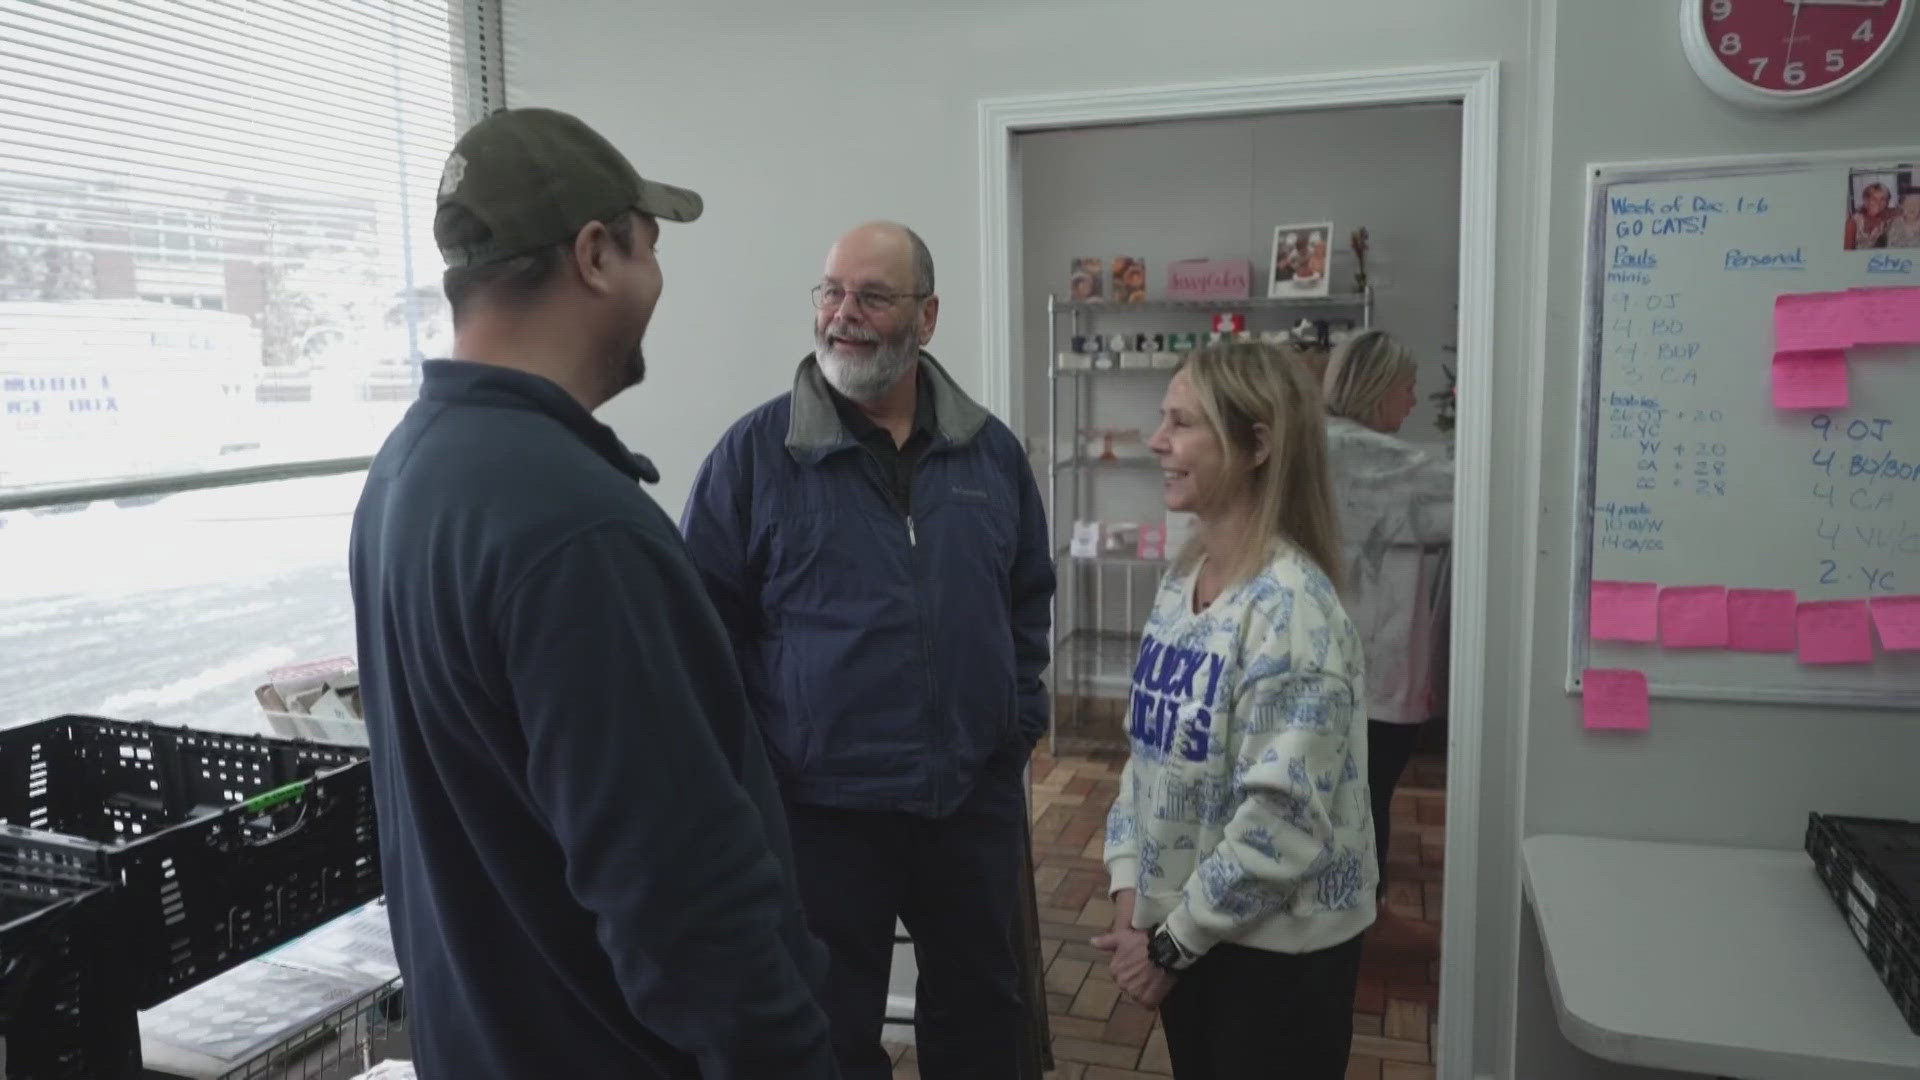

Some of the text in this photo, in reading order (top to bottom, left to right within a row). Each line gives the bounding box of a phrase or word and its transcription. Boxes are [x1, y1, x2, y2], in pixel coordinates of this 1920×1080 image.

[1710, 0, 1732, 21] 9
[1852, 19, 1874, 42] 4
[1719, 33, 1742, 55] 8
[1749, 57, 1769, 81] 7
[1825, 49, 1845, 72] 5
[1783, 62, 1806, 85] 6
[1611, 196, 1655, 215] Week
[1660, 194, 1683, 214] of
[1616, 214, 1707, 238] GO CATS!
[1811, 415, 1893, 442] 9 OJ
[1812, 449, 1836, 477] 4
[1813, 482, 1834, 509] 4
[1820, 559, 1896, 591] 2 YC
